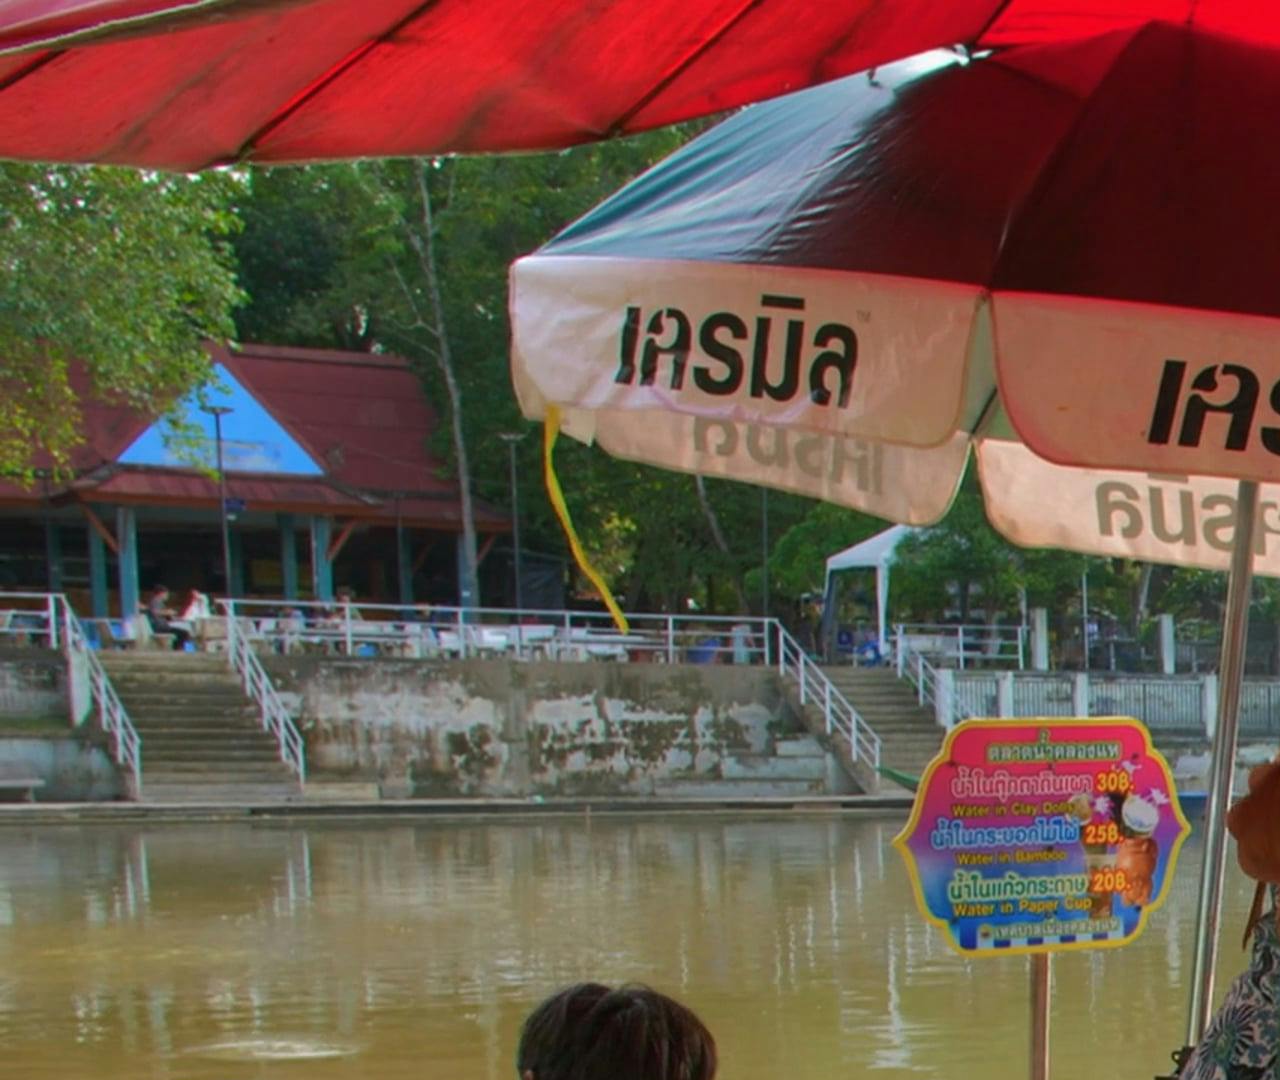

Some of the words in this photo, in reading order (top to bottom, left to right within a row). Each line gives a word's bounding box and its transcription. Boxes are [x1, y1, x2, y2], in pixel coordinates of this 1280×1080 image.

[614, 293, 859, 409] เครมิล
[953, 804, 989, 817] Water
[956, 851, 993, 865] Water
[954, 903, 995, 917] Water
[1000, 903, 1013, 914] in
[1019, 899, 1058, 916] Paper
[1065, 897, 1092, 912] Cup
